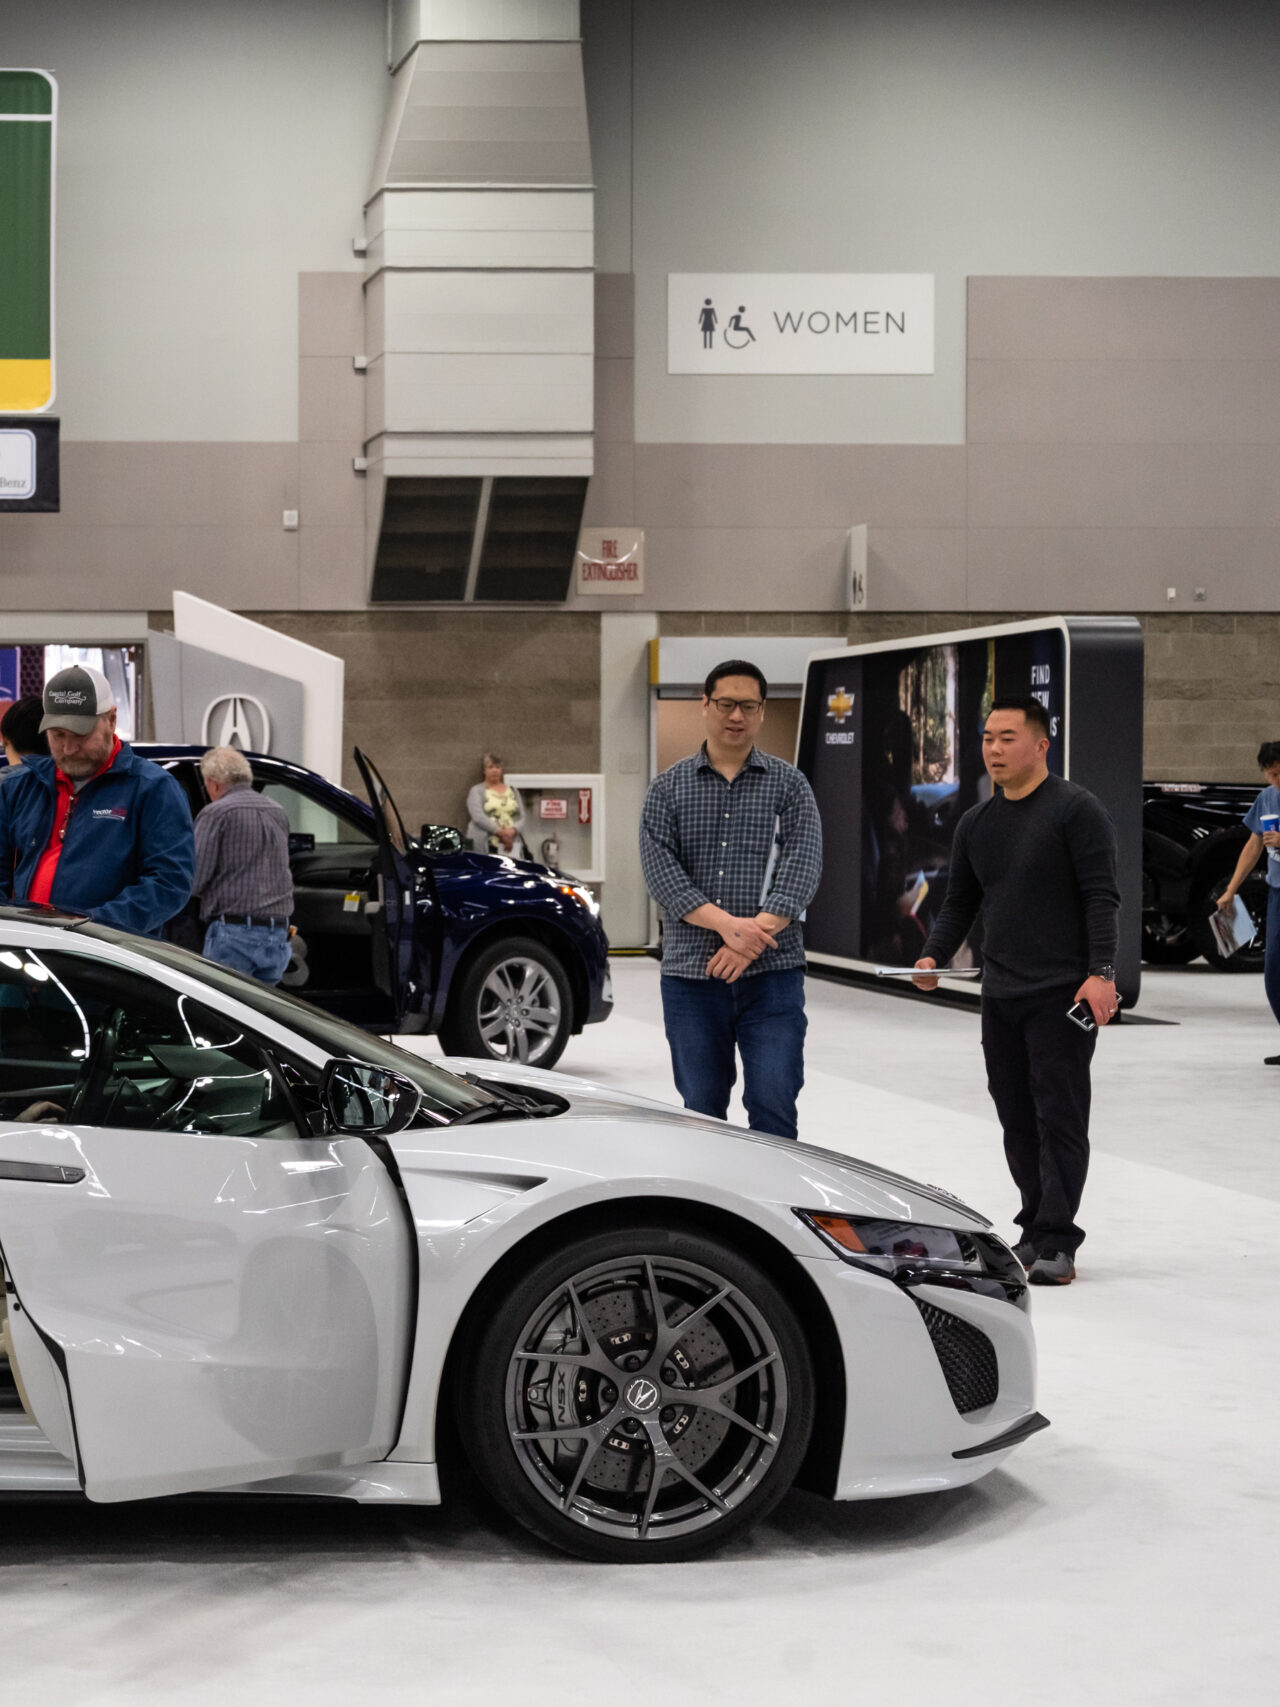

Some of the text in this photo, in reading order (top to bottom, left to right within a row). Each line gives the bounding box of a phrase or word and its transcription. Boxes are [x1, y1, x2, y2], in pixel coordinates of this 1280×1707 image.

[773, 311, 906, 335] WOMEN
[1031, 664, 1051, 685] FIND
[1031, 690, 1050, 710] EW
[558, 1368, 566, 1423] NSX
